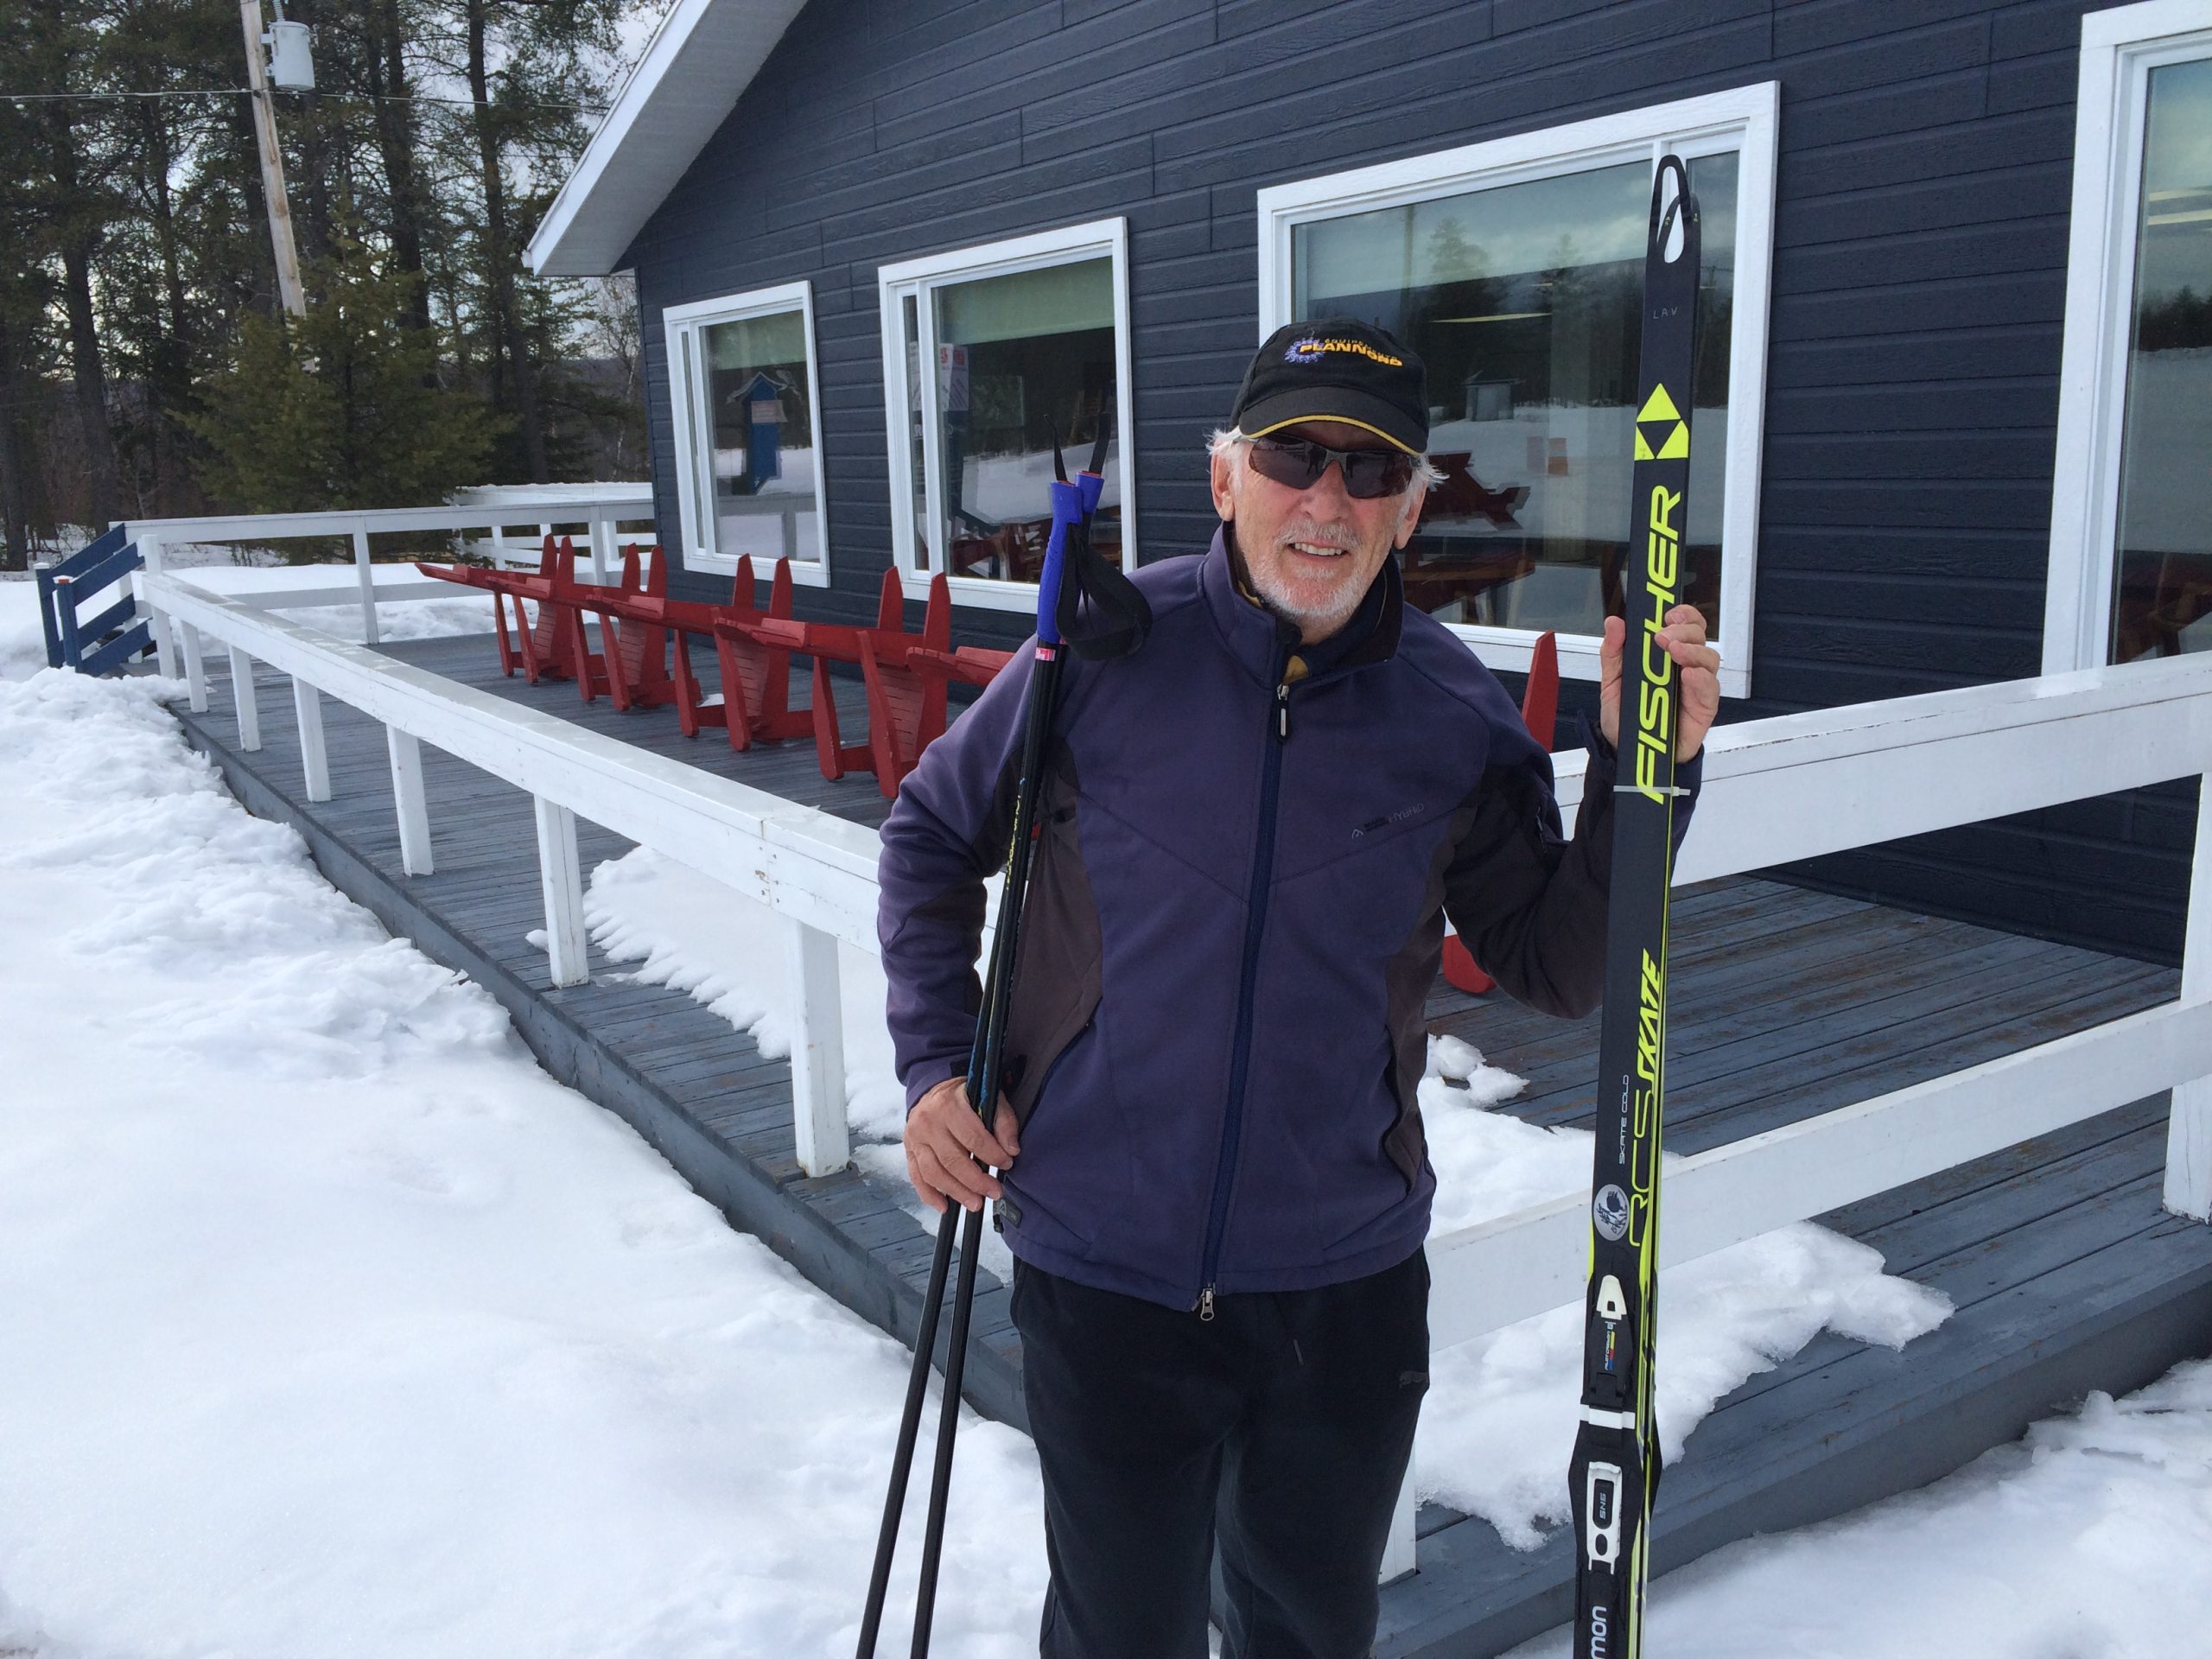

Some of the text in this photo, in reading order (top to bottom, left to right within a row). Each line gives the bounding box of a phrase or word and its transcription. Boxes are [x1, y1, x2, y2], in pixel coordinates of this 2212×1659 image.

[1653, 306, 1678, 320] LAV
[1300, 343, 1403, 366] PLANNORD
[1636, 485, 1681, 804] FISCHER
[1637, 948, 1661, 1082] SKATE
[1618, 1074, 1630, 1165] SKATE COLD
[1591, 1605, 1607, 1659] mon
